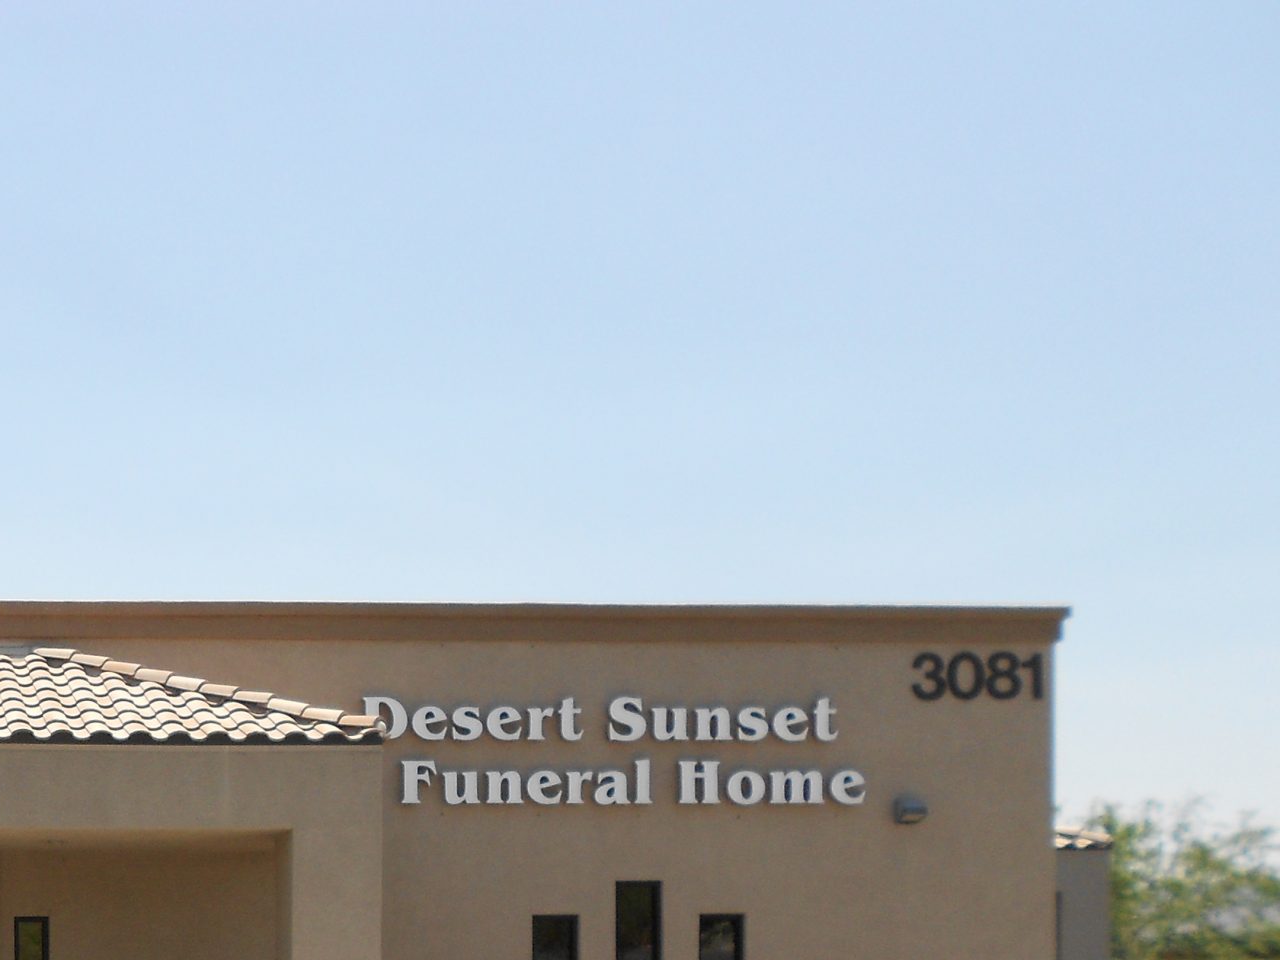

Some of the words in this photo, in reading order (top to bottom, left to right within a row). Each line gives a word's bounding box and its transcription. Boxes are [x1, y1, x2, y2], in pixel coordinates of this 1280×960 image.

[912, 652, 1044, 700] 3081
[363, 697, 584, 741] Desert
[608, 696, 839, 742] Sunset
[401, 759, 652, 805] Funeral
[678, 760, 866, 805] Home
